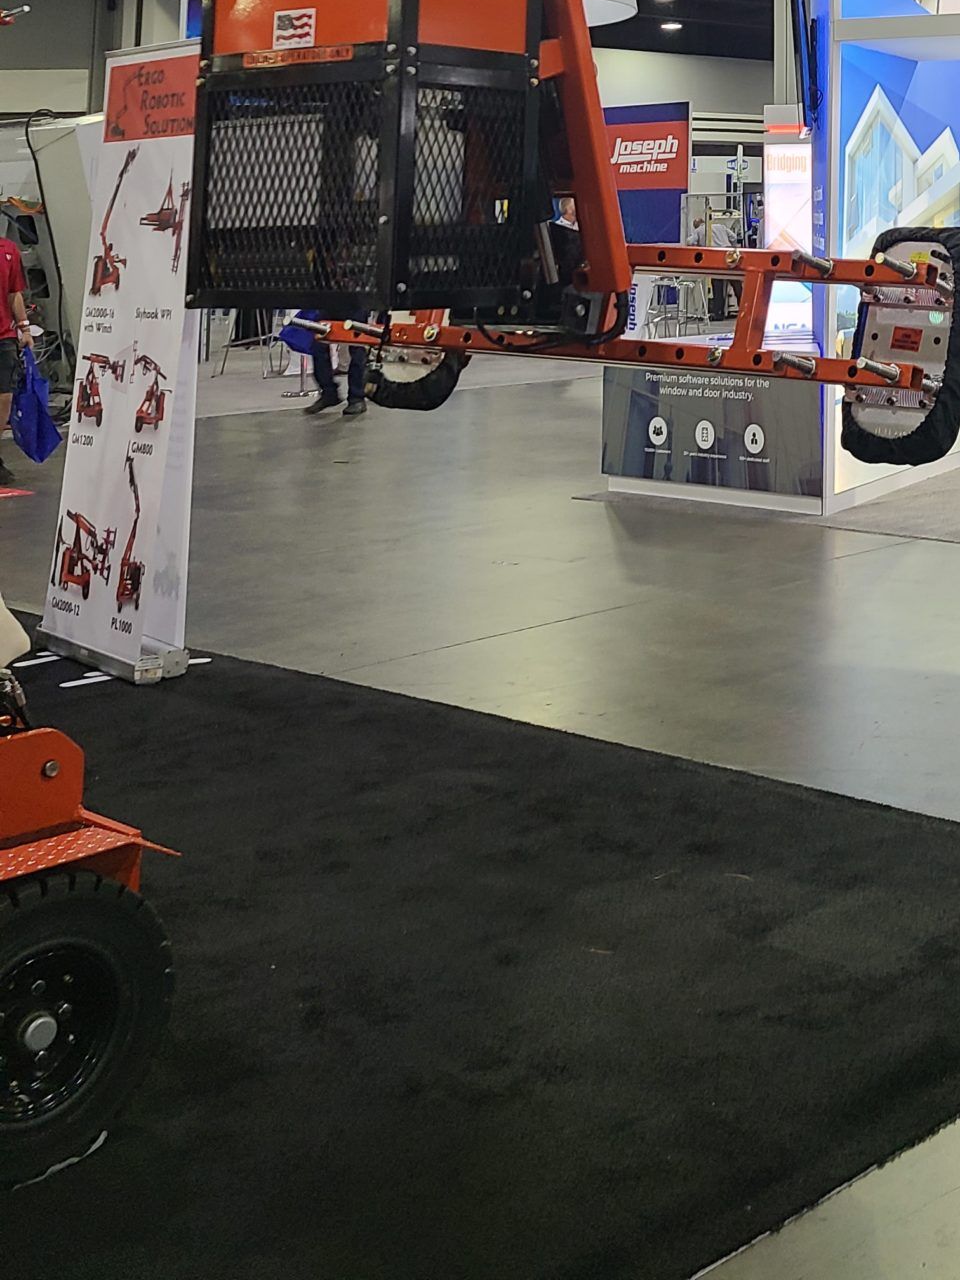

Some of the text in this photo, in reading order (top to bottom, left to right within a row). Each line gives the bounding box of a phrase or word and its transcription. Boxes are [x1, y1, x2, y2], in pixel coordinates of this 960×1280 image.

[141, 90, 186, 111] ROBOTIC
[611, 135, 679, 164] Joseph
[619, 160, 668, 174] machine
[766, 153, 807, 173] Bridging
[645, 372, 770, 388] Premium software solutions for the
[660, 385, 754, 402] window and door industry.
